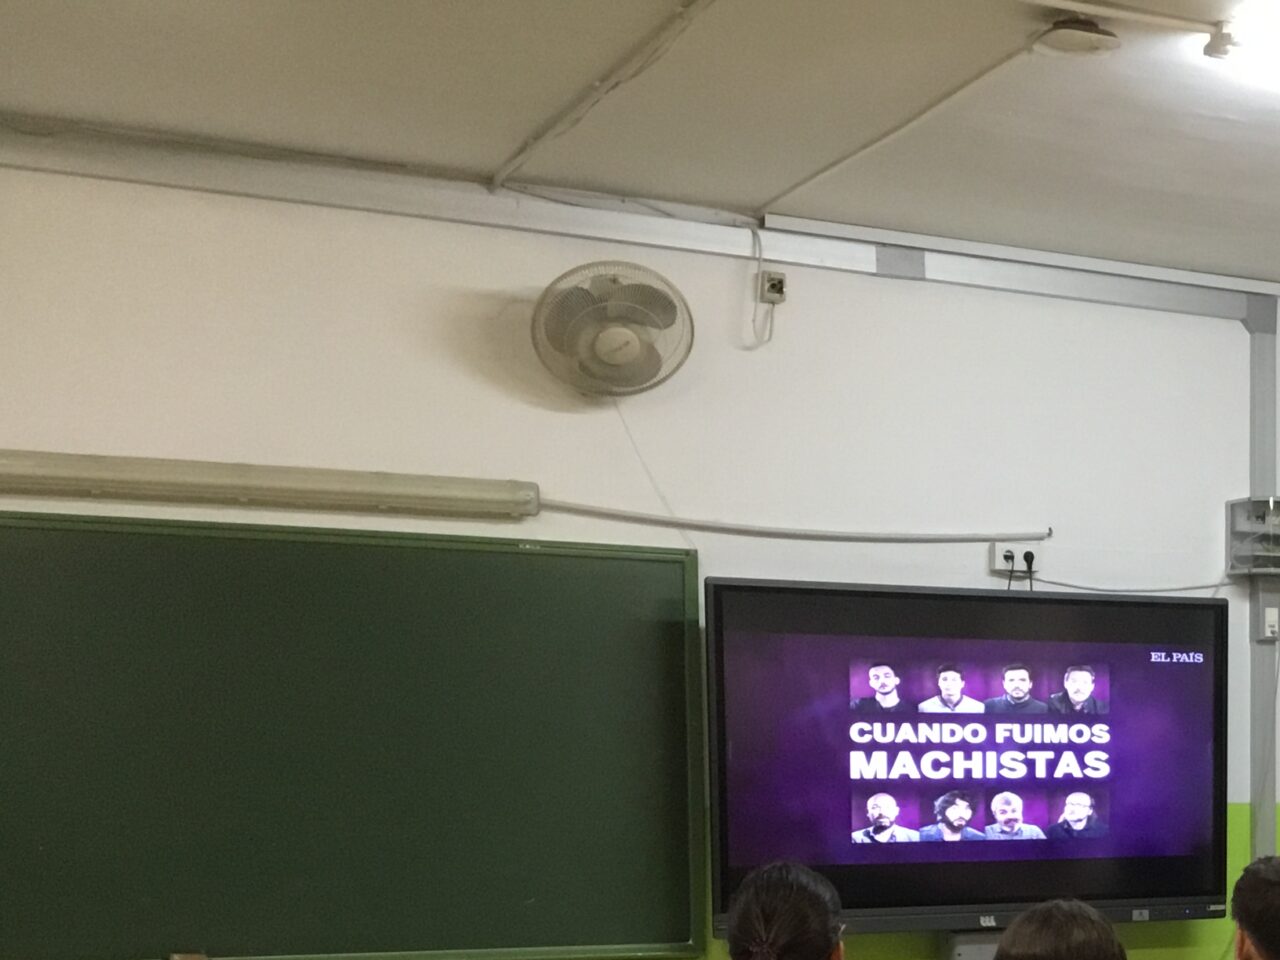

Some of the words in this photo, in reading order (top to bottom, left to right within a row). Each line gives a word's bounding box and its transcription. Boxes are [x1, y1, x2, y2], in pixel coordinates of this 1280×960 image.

[1150, 651, 1170, 662] EL
[849, 722, 987, 744] CUANDO
[995, 723, 1111, 744] FUIMOS
[849, 750, 1111, 780] MACHISTAS
